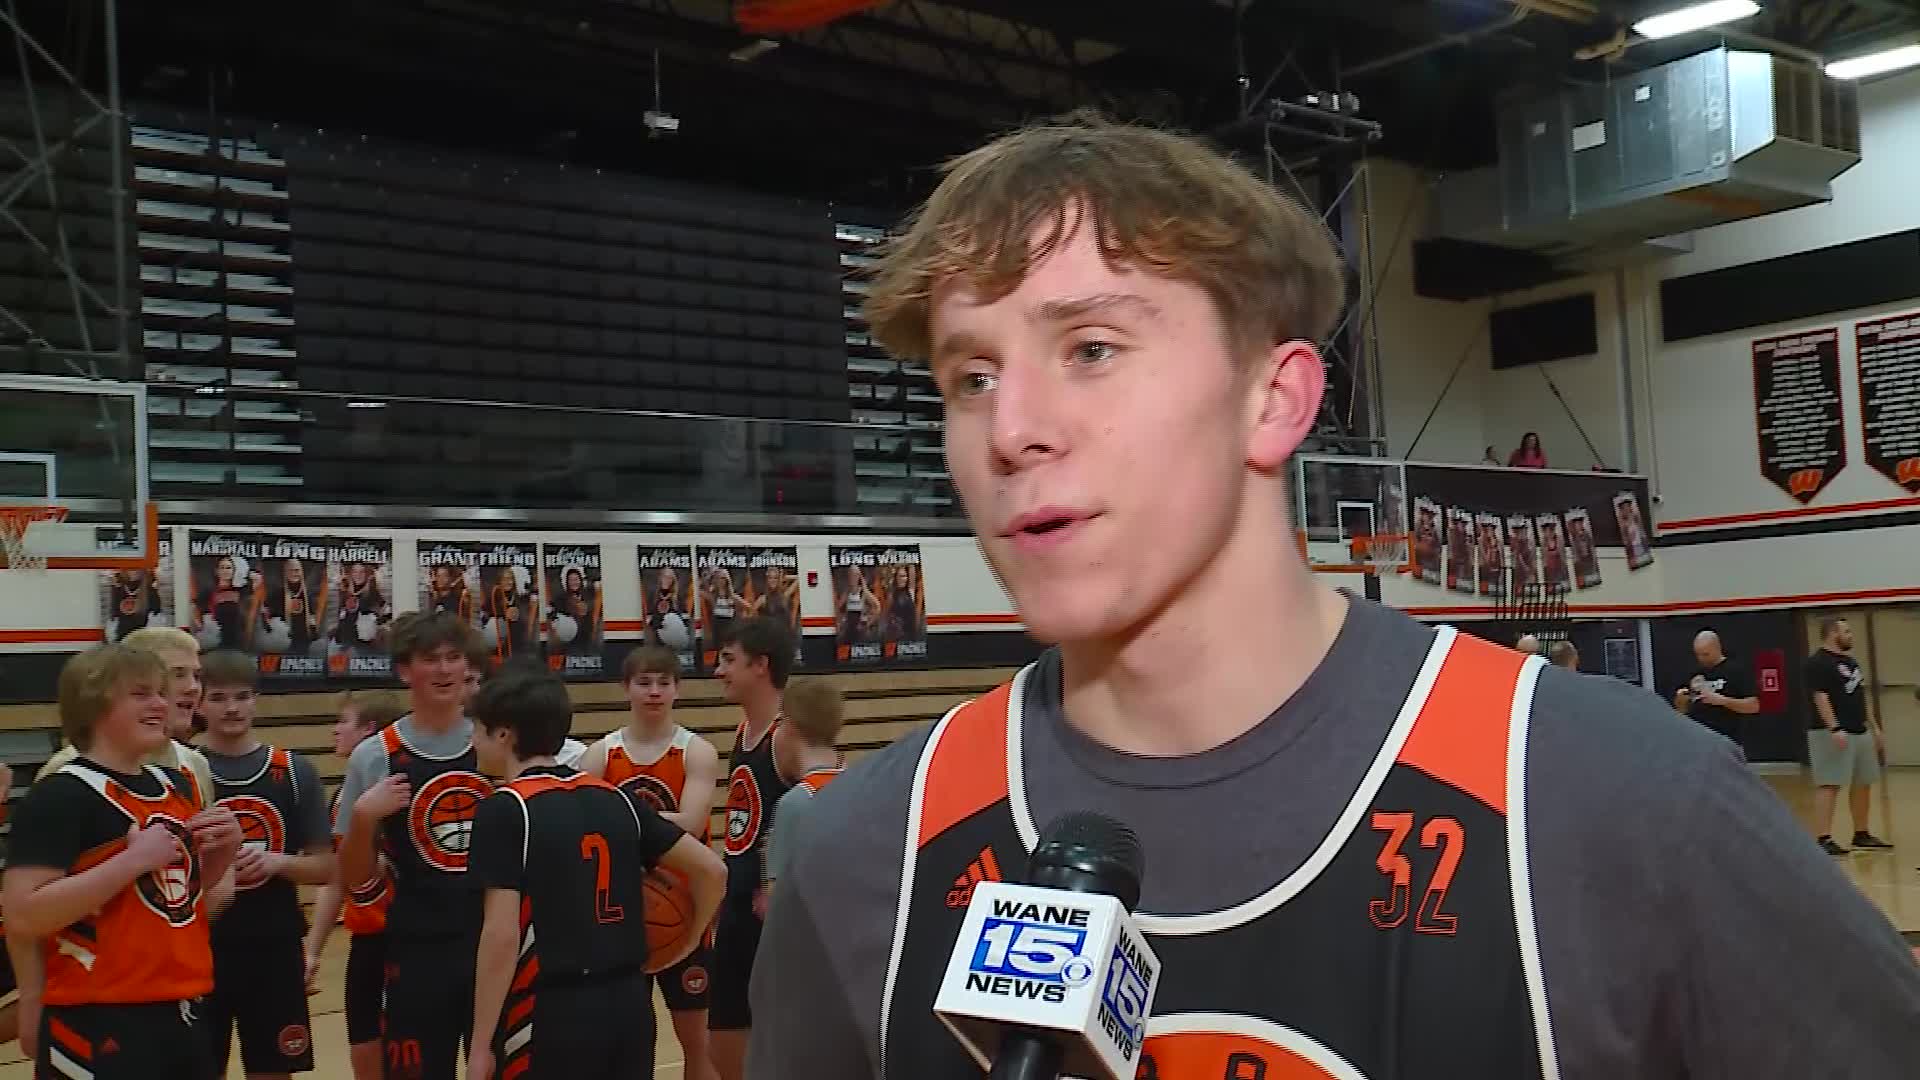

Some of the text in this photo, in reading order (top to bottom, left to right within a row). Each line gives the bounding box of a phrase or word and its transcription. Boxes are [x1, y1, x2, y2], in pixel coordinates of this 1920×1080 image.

[262, 544, 326, 560] LONG
[419, 551, 479, 565] GRANT
[480, 553, 535, 565] FRIEND
[640, 556, 690, 567] ADAMS
[699, 556, 746, 567] ADAMS
[581, 833, 624, 924] 2
[1369, 811, 1465, 934] 32
[993, 899, 1090, 927] WANE
[983, 923, 1079, 975] 15
[1119, 924, 1152, 988] WANE
[965, 974, 1066, 1003] NEWS
[1106, 954, 1147, 1031] 15
[1098, 1002, 1133, 1062] NEWS
